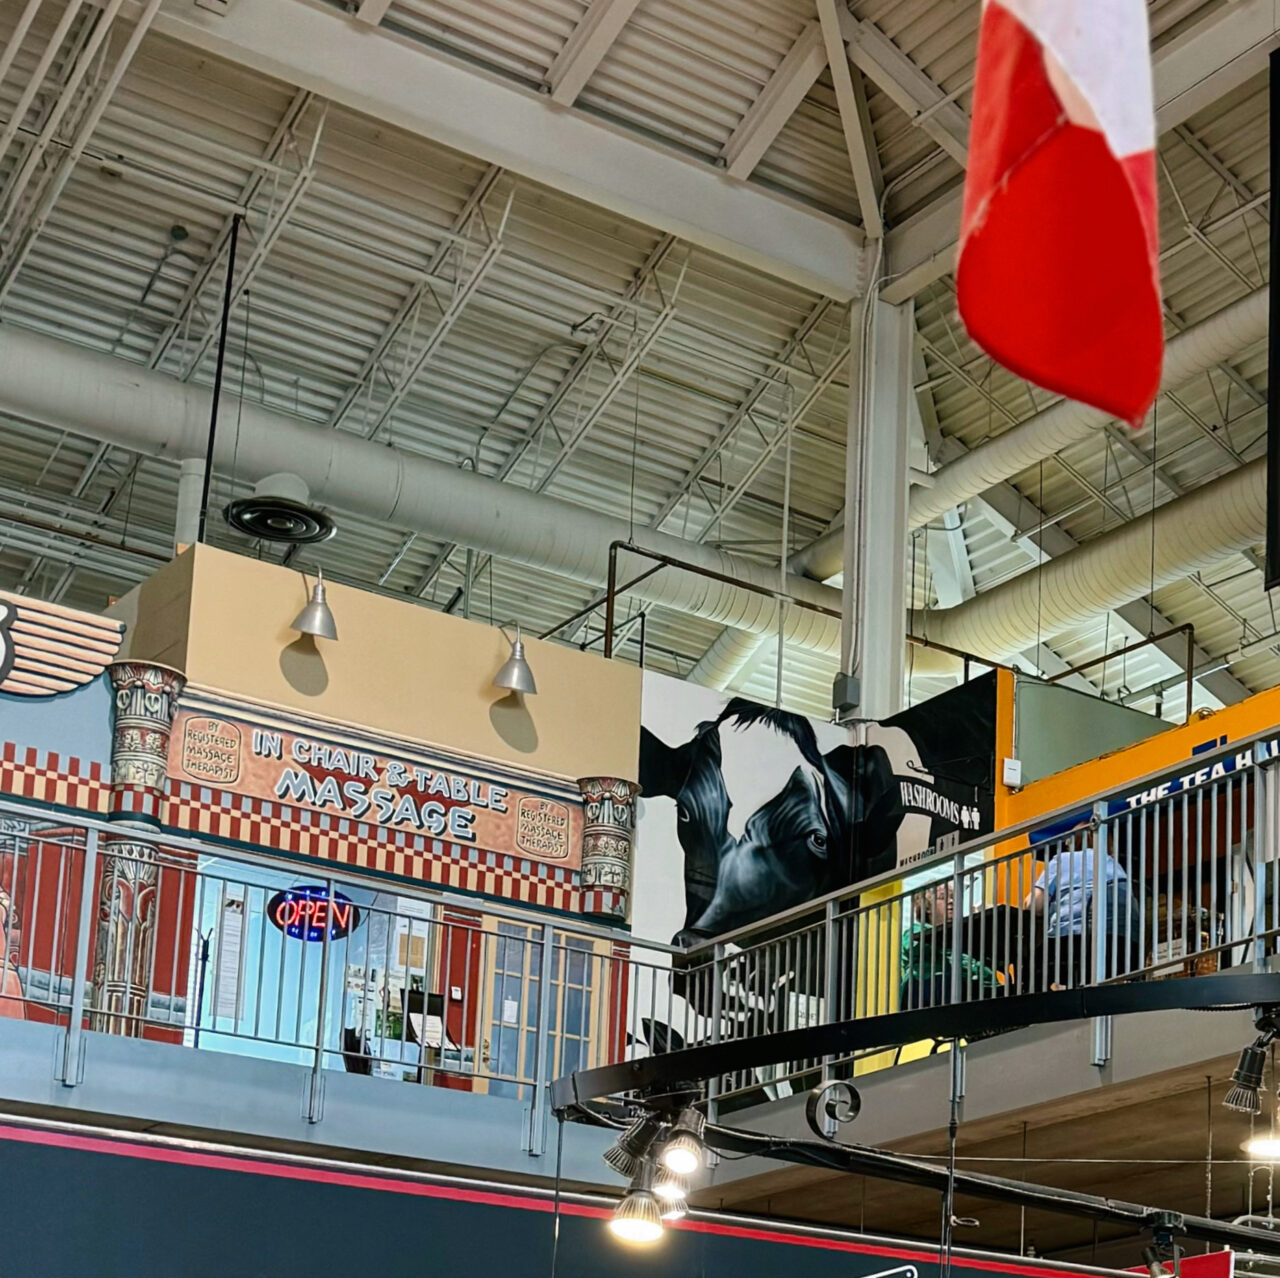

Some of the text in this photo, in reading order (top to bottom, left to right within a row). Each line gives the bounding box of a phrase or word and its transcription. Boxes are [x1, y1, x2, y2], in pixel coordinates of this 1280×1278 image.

[207, 720, 220, 732] BY
[187, 728, 237, 749] REGISTERED
[186, 745, 235, 764] MASSAGE
[185, 759, 235, 778] THERAPIST
[252, 729, 509, 815] IN CHAIR & TABLE
[274, 767, 477, 843] MASSAGE
[539, 800, 550, 811] BY
[899, 781, 960, 824] WASHROOMS
[1125, 782, 1172, 809] THE
[520, 808, 566, 827] REGISTERED
[520, 822, 565, 840] MASSAGE
[519, 835, 566, 856] THERAPIST
[275, 900, 350, 928] OPEN
